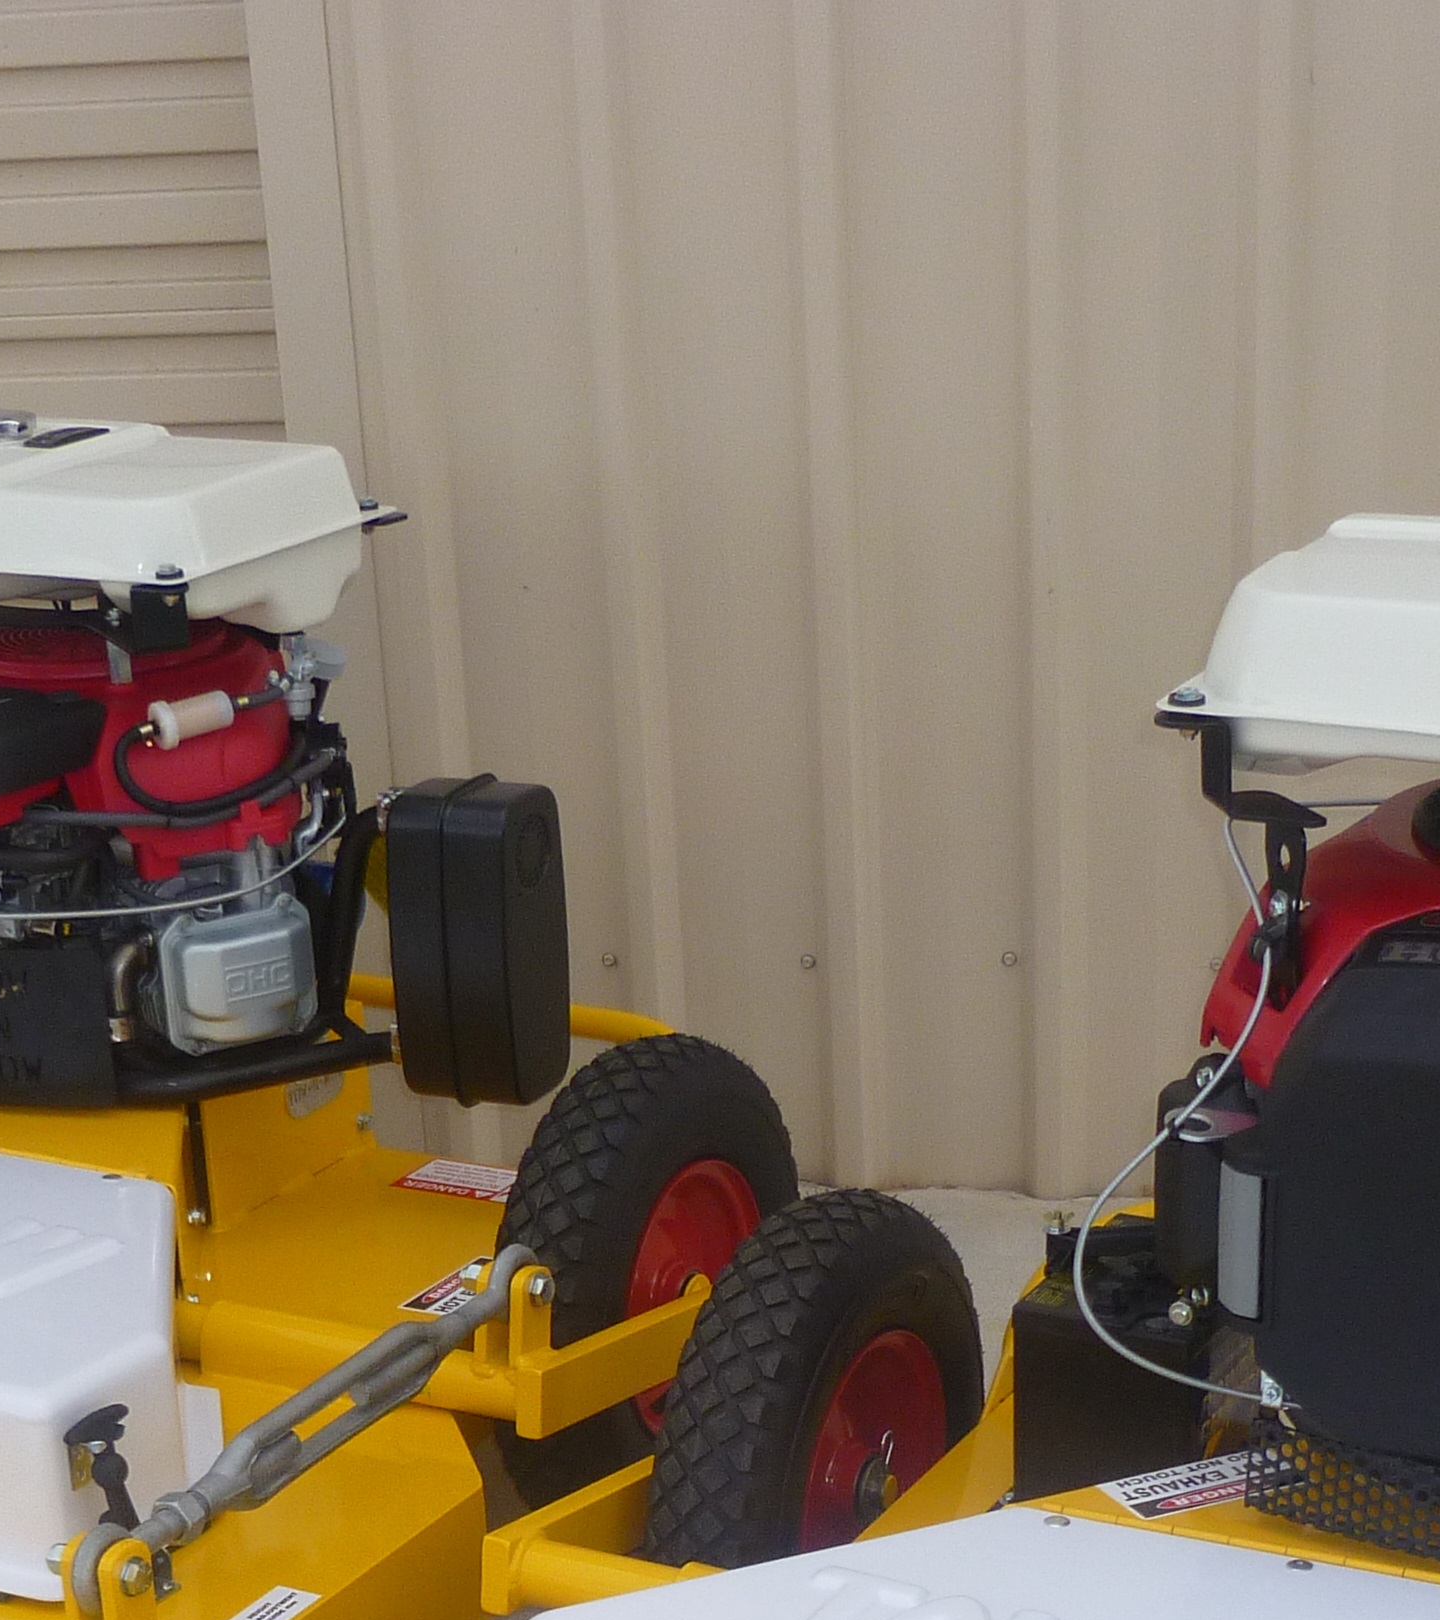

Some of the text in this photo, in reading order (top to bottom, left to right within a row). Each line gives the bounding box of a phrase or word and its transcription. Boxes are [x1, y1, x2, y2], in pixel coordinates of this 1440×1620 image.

[225, 962, 291, 994] OHC
[403, 1179, 471, 1195] DANGER
[434, 1296, 467, 1313] HOT
[1186, 1459, 1224, 1471] NOT
[1116, 1469, 1182, 1488] TOUCH
[1121, 1470, 1229, 1501] EXHAUST
[1174, 1484, 1247, 1507] ANGER
